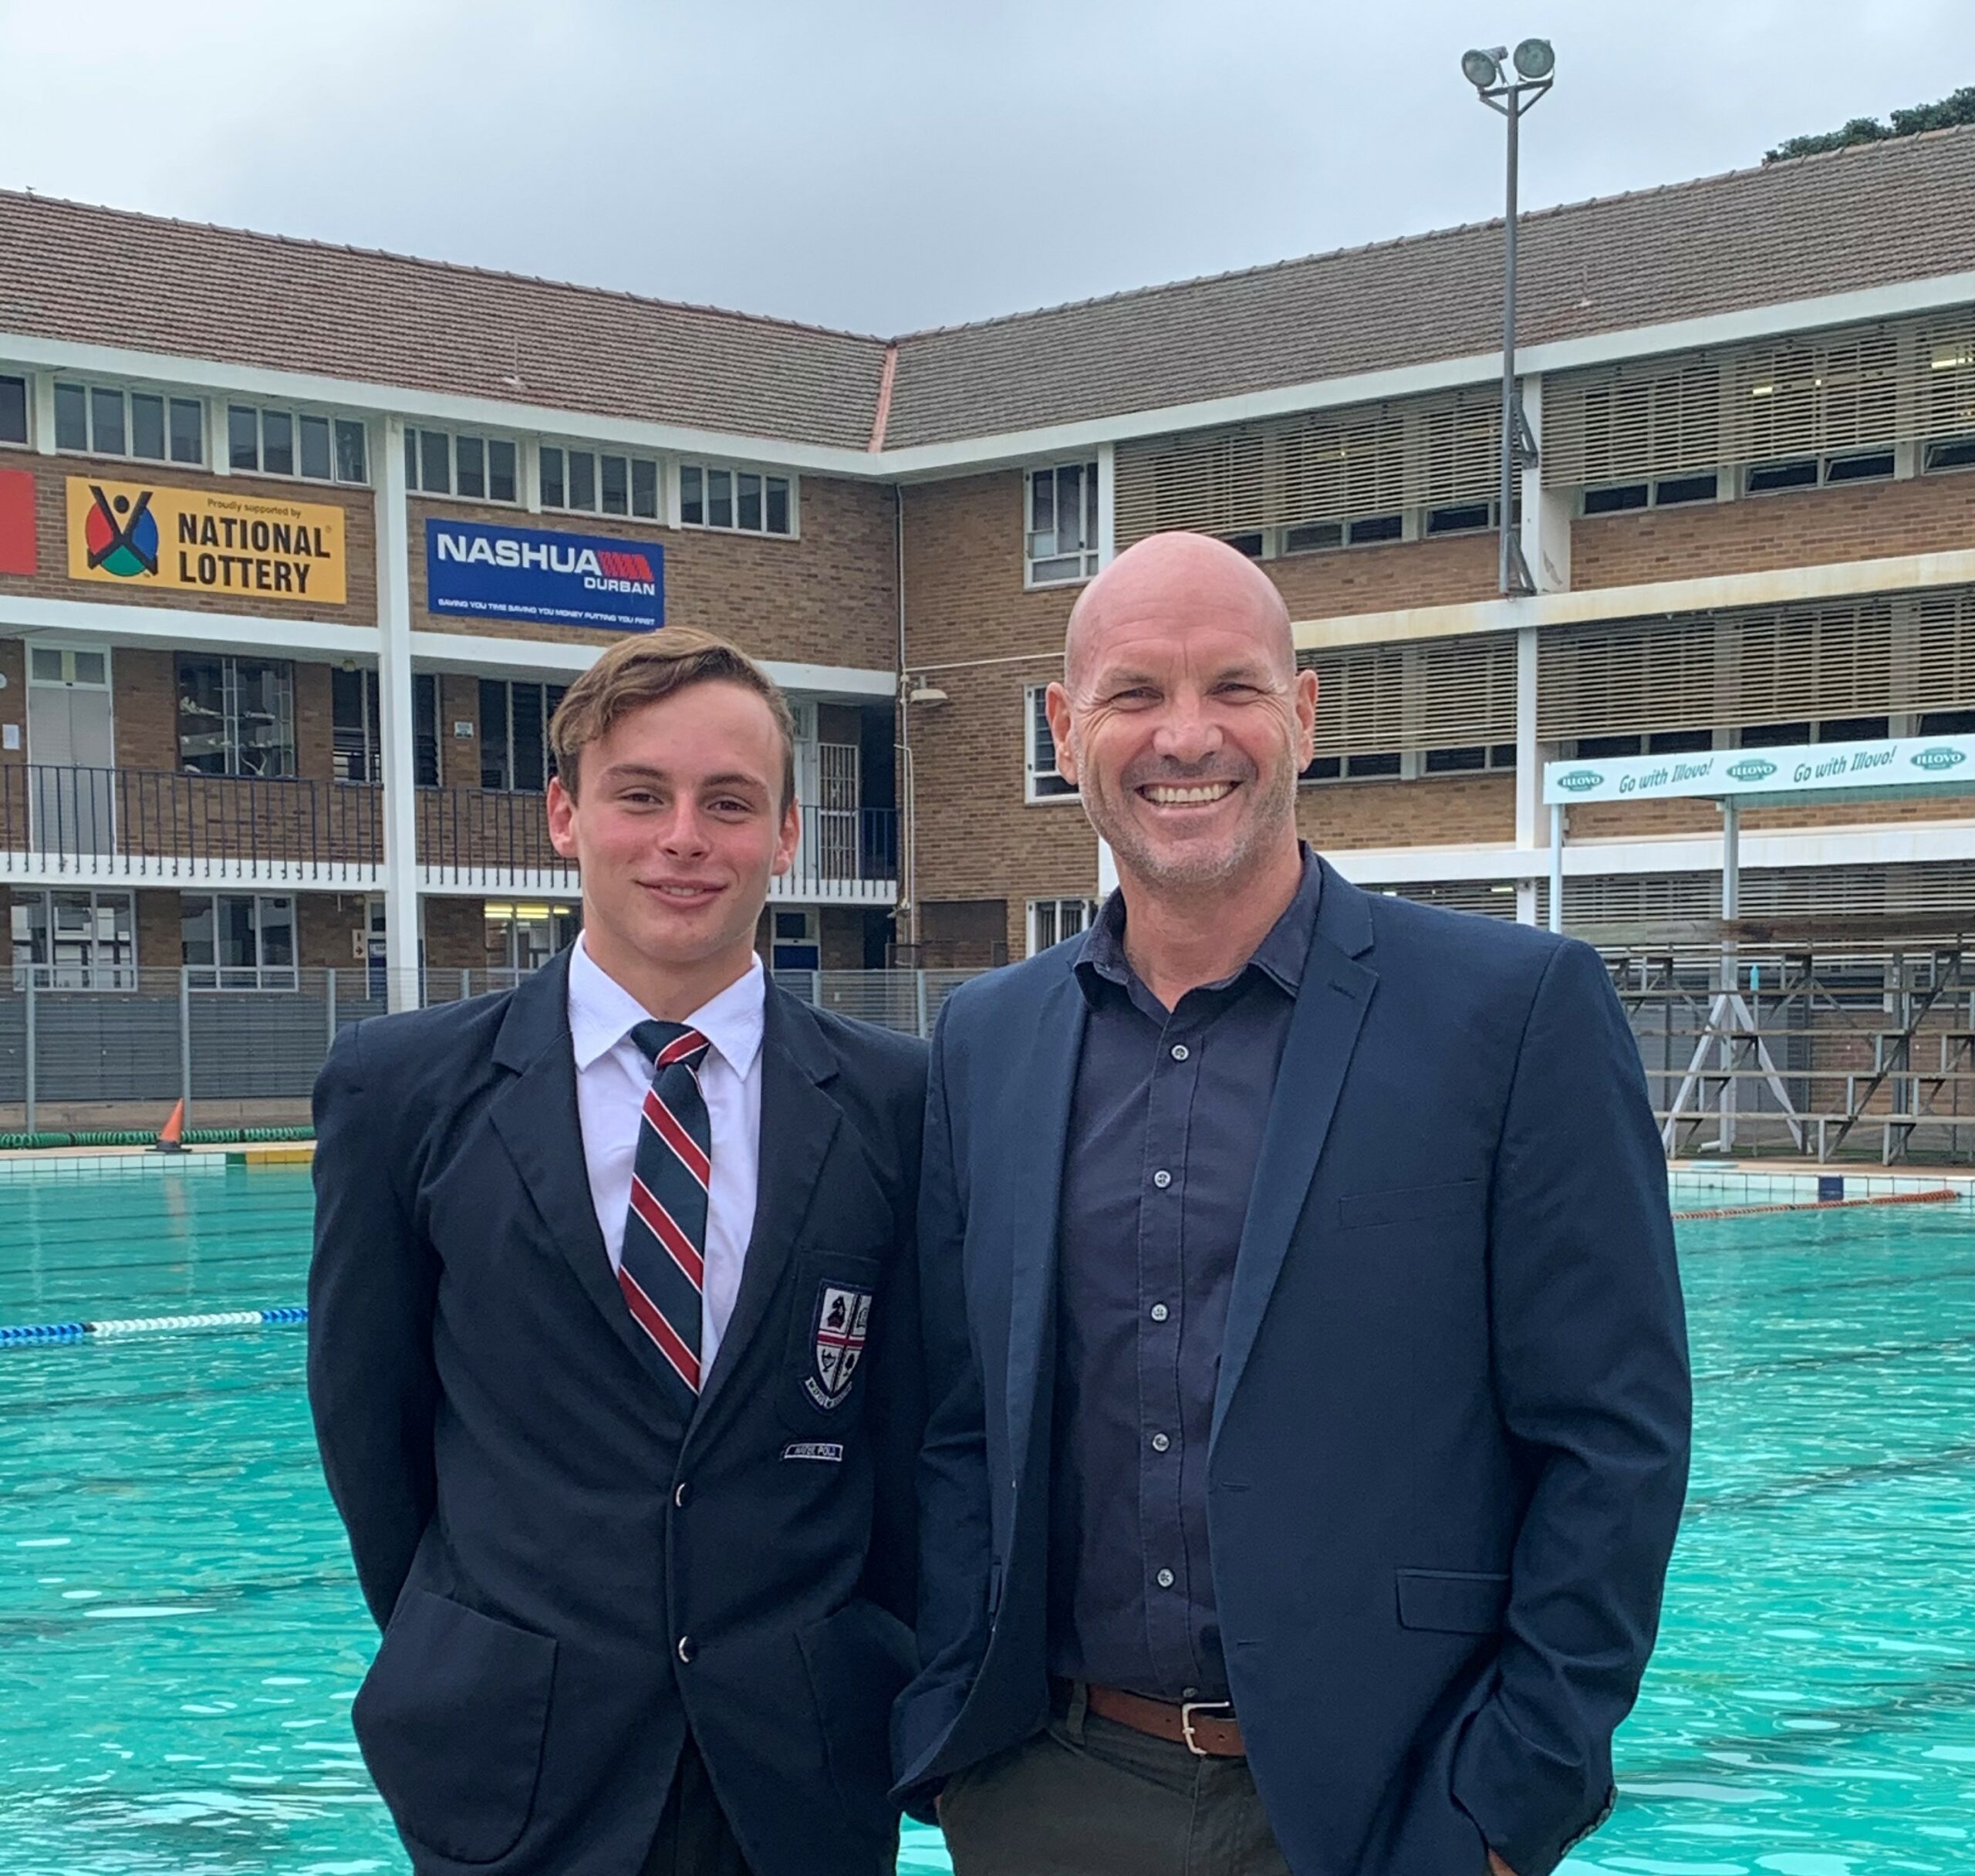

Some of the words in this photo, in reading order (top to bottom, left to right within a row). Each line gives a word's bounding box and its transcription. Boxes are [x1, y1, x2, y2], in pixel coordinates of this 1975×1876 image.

[207, 498, 242, 511] Proudly
[245, 504, 289, 516] supported
[291, 508, 301, 519] by
[178, 513, 330, 558] NATIONAL
[179, 551, 311, 594] LOTTERY
[437, 533, 603, 576] NASHUA
[584, 576, 655, 596] DURBAN
[438, 599, 468, 608] SAVING
[508, 605, 537, 614] SAVING
[555, 609, 584, 618] MONEY
[585, 612, 616, 622] PUTTING
[635, 617, 655, 626] FIRST
[1619, 774, 1636, 793] Go
[1639, 768, 1668, 789] with
[1671, 757, 1714, 782] Illovo!
[1794, 763, 1811, 782] Go
[1815, 756, 1847, 778] with
[1850, 745, 1898, 771] Illovo!
[1916, 754, 1962, 764] ILLOVO
